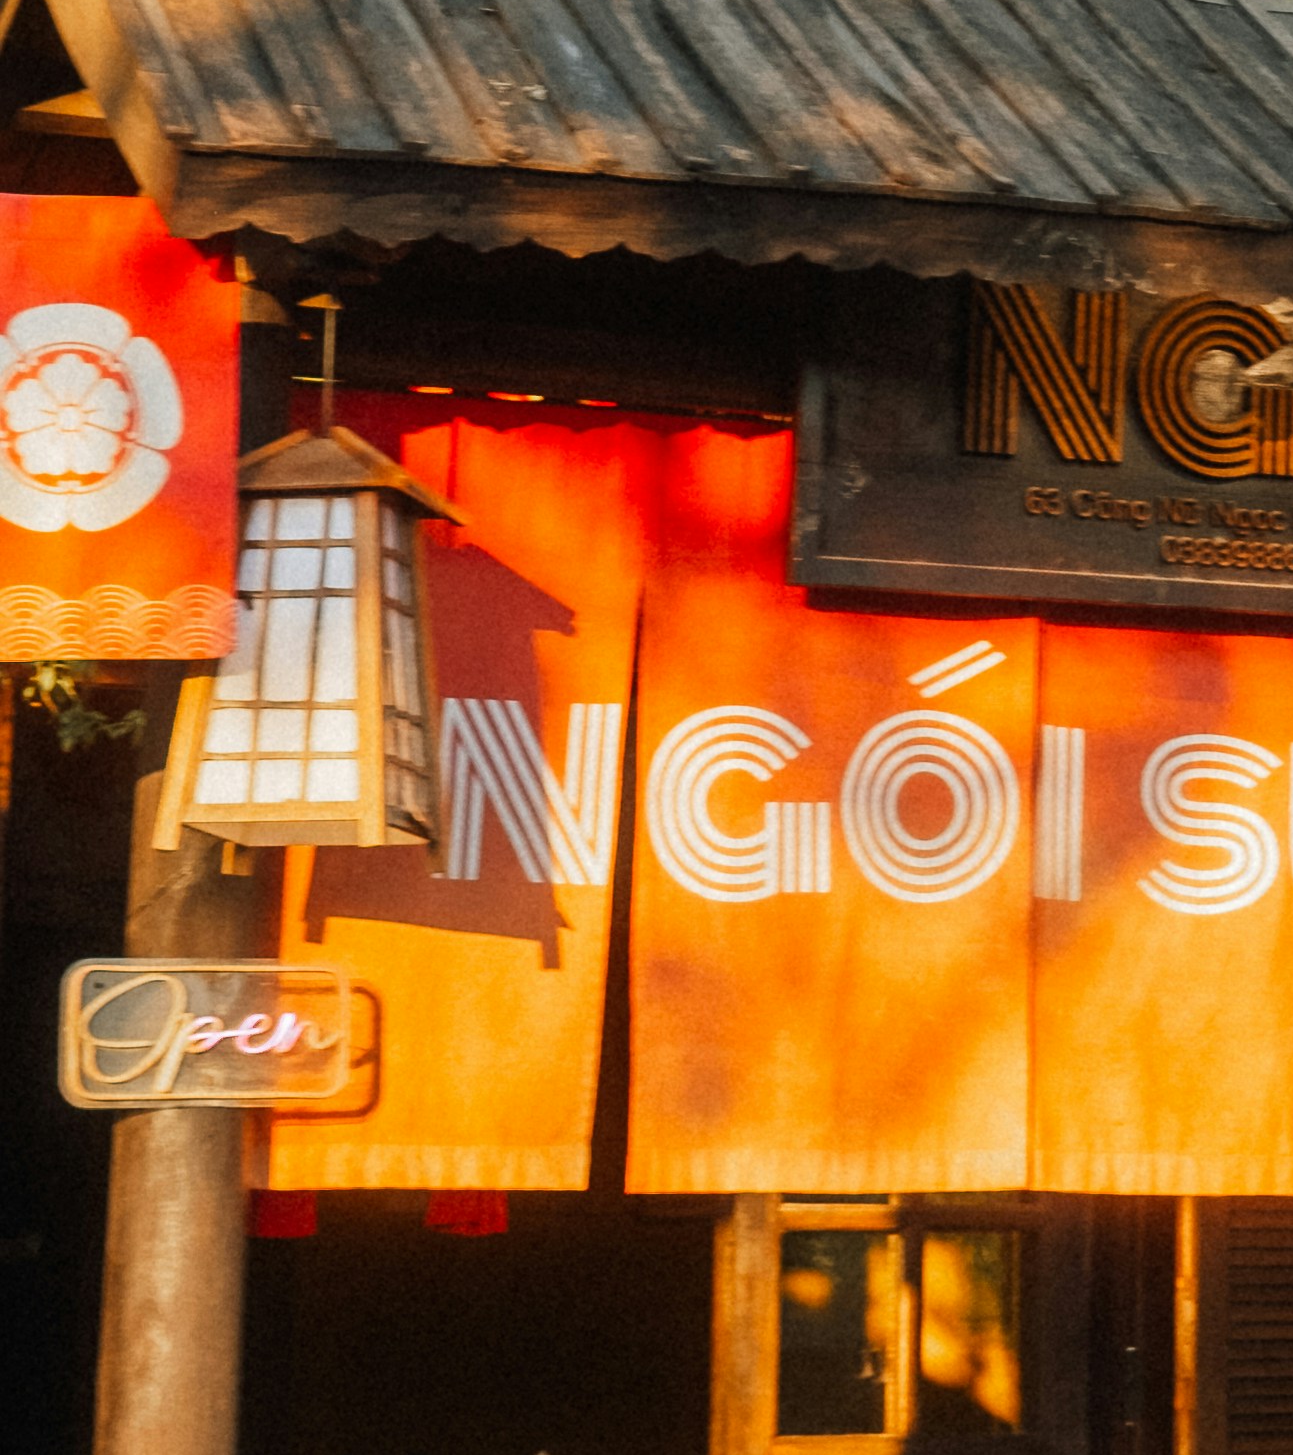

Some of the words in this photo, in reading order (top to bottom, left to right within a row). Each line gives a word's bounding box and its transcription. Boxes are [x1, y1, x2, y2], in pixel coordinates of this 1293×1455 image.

[1024, 486, 1064, 516] 63
[440, 640, 1086, 904] NGÓI
[81, 973, 343, 1094] Open
